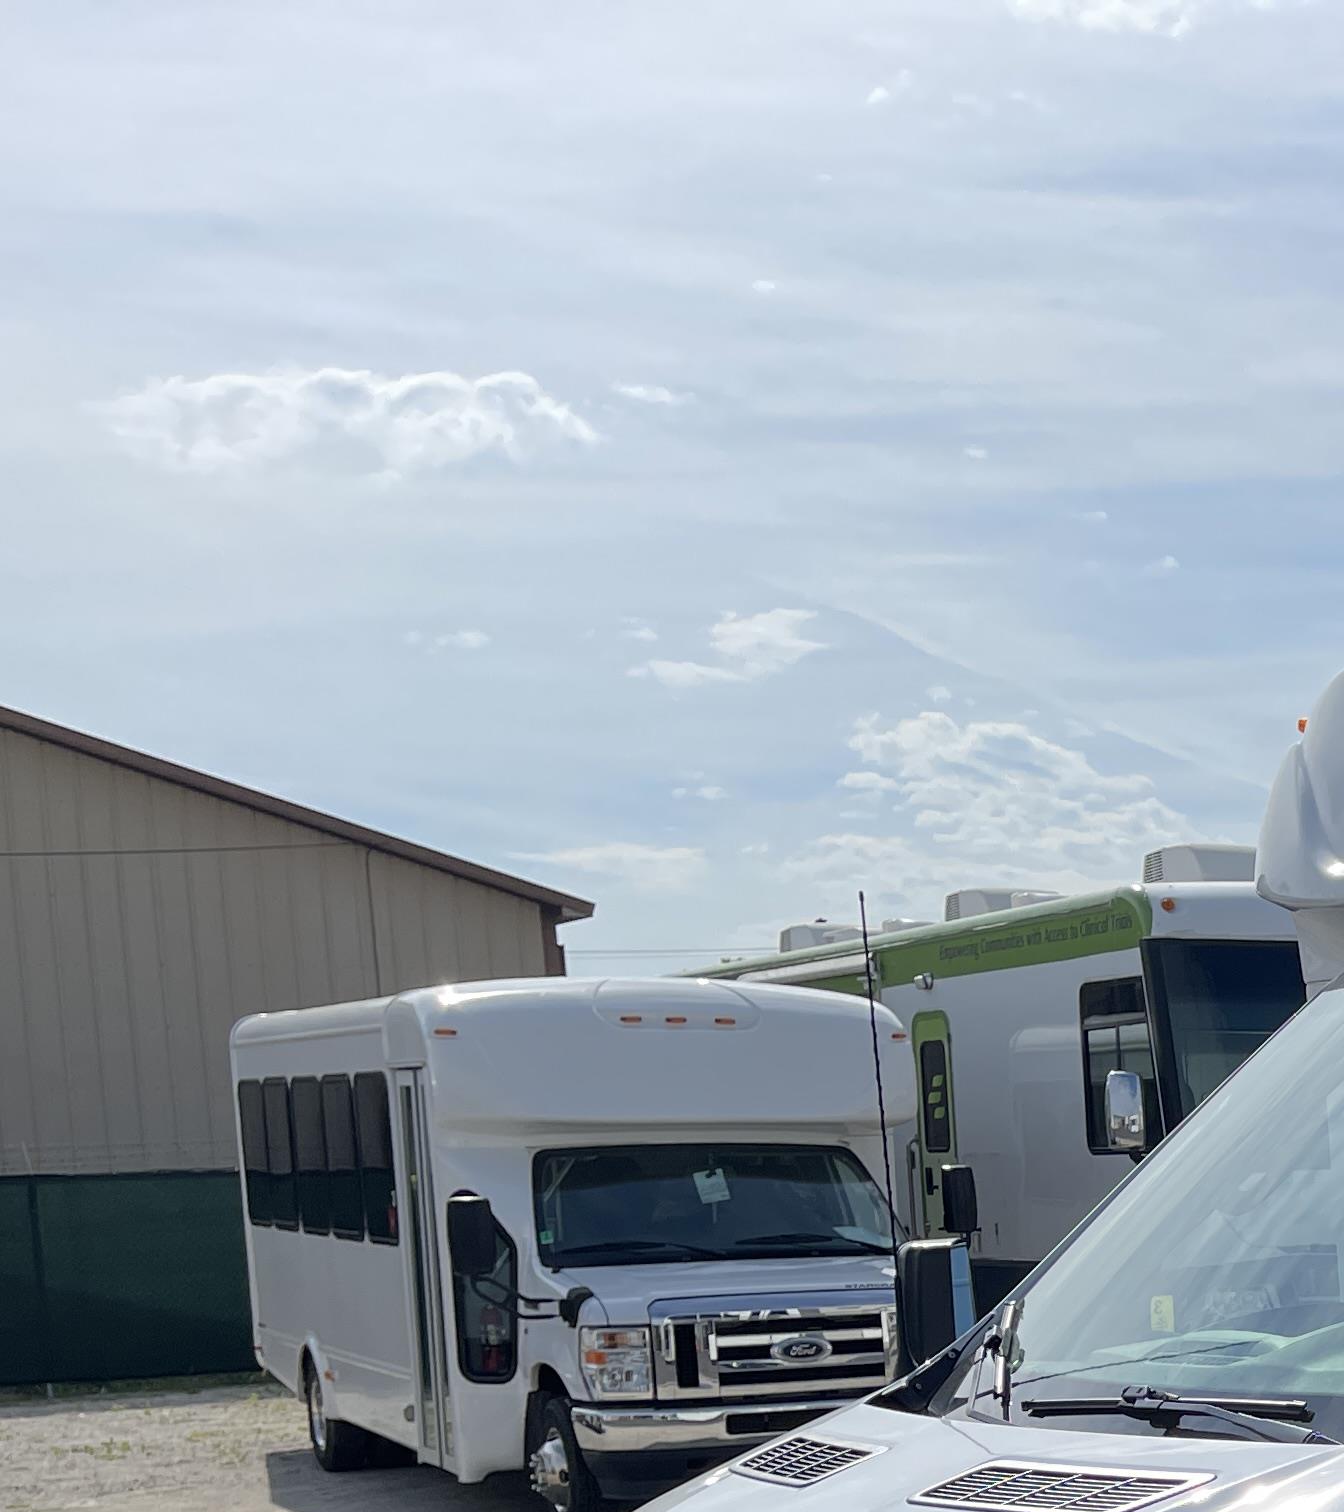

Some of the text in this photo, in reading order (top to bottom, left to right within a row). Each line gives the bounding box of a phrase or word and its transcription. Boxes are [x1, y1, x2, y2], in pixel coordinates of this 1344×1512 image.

[939, 942, 979, 960] Empowering
[981, 935, 1024, 953] Communities
[1026, 931, 1042, 945] with
[1044, 928, 1070, 942] Access
[1070, 924, 1079, 939] to
[790, 1343, 817, 1356] Ford
